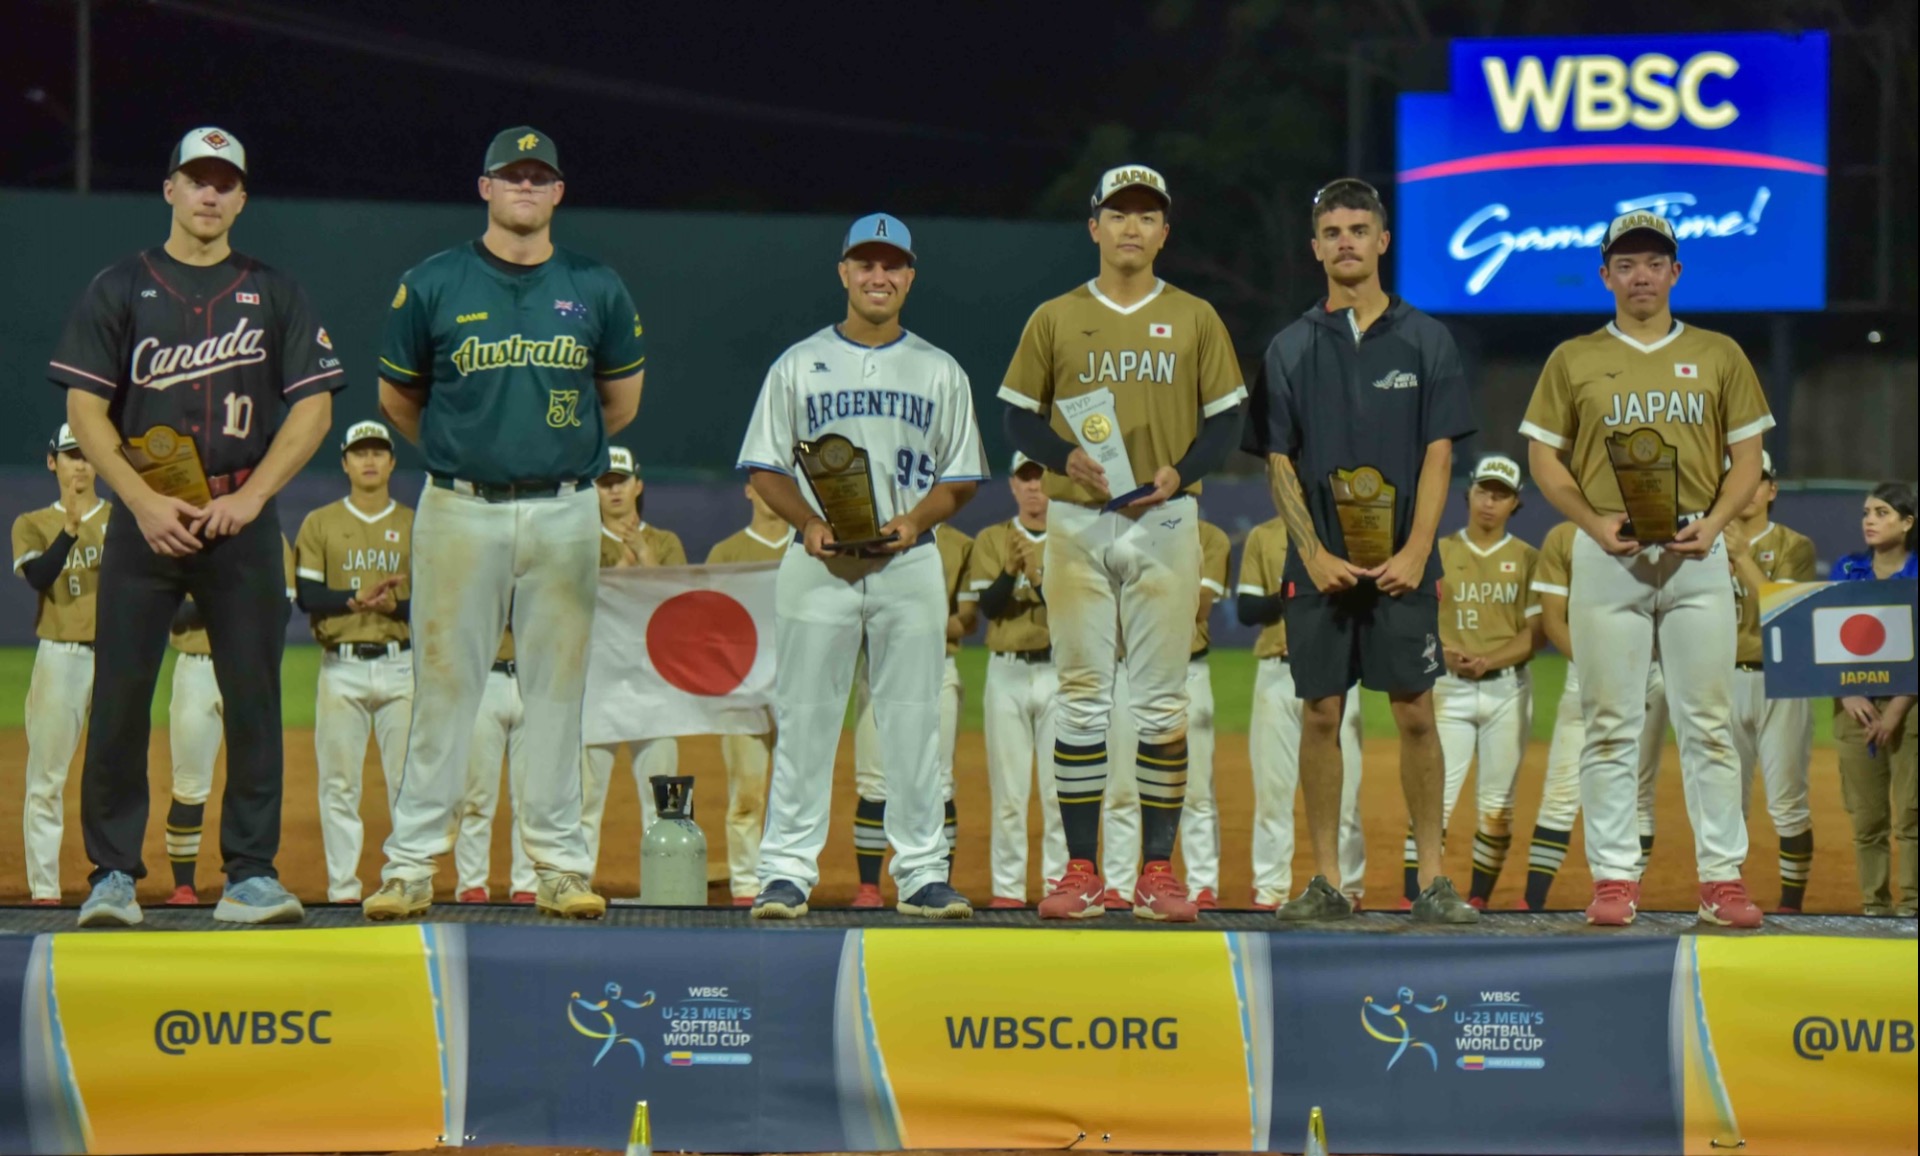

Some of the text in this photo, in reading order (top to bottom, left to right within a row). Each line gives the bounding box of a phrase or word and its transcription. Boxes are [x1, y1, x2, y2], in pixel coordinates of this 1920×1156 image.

[1482, 51, 1740, 133] WBSC
[1111, 169, 1159, 187] JAPAN
[875, 218, 888, 238] A
[1617, 214, 1666, 233] JAPAN
[1449, 203, 1608, 296] Game
[456, 312, 489, 323] GAME
[131, 317, 265, 386] Canada
[452, 334, 588, 376] Australia
[1078, 350, 1176, 384] JAPAN
[547, 390, 581, 427] 57
[806, 390, 935, 437] ARGENTINA
[1065, 396, 1091, 414] MVP
[1603, 390, 1704, 426] JAPAN
[223, 392, 253, 439] 10
[352, 426, 384, 438] JAPAN
[895, 447, 936, 489] 95
[1483, 462, 1516, 478] JAPAN
[343, 549, 400, 572] JAPAN
[69, 576, 80, 596] 6
[1454, 581, 1518, 603] JAPAN
[1457, 609, 1479, 630] 12
[1840, 671, 1890, 685] JAPAN
[688, 986, 728, 998] WBSC
[1480, 991, 1520, 1002] WBSC
[662, 1007, 752, 1020] U-23 MEN'S
[1454, 1011, 1544, 1025] U-23 MEN'S
[154, 1010, 332, 1056] @WBSC
[671, 1020, 743, 1033] SOFTBALL
[945, 1016, 1178, 1050] WBSC.ORG
[1463, 1024, 1535, 1037] SOFTBALL
[663, 1033, 751, 1047] WORLD CUP
[1456, 1037, 1543, 1051] WORLD CUP
[1792, 1016, 1915, 1060] @WB
